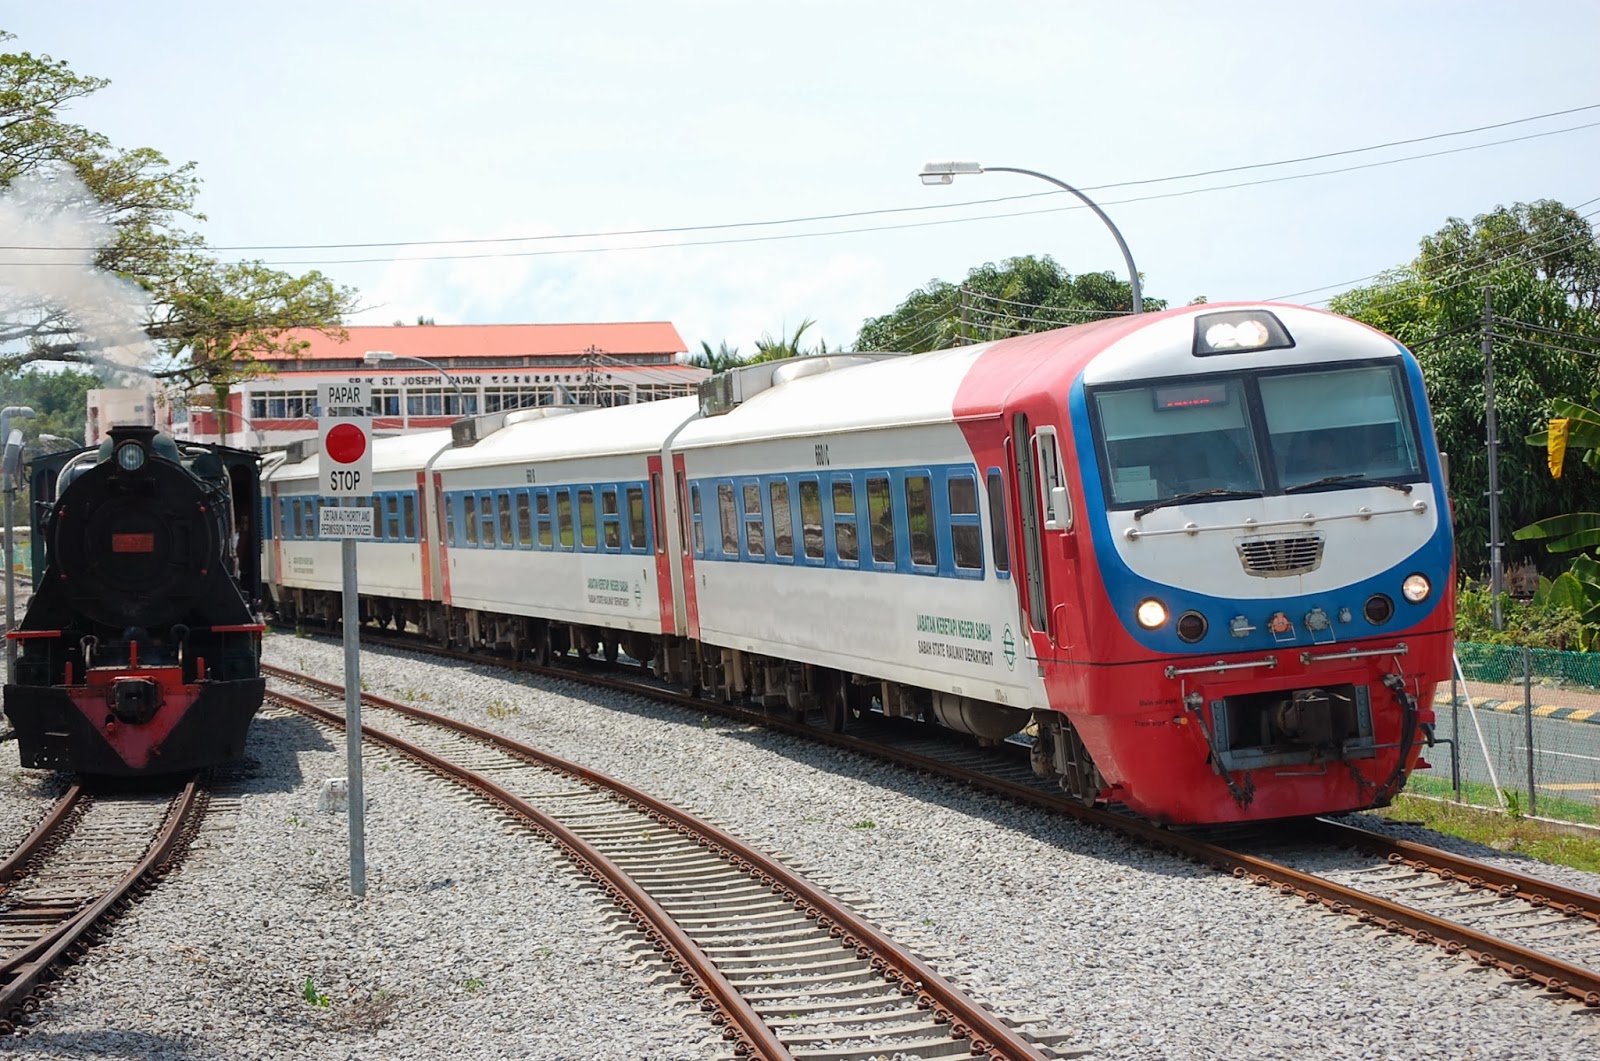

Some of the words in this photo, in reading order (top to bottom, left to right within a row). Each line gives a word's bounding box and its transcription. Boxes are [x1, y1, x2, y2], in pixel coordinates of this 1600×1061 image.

[382, 377, 396, 386] ST.
[401, 376, 442, 386] JOSEPH
[448, 376, 481, 385] PAPAR
[328, 387, 360, 403] PAPAR
[330, 471, 361, 491] STOP
[916, 614, 936, 633] JABATAN
[935, 616, 958, 637] KERETAPI
[957, 619, 975, 639] NEGERI
[975, 622, 992, 642] SABAH
[918, 640, 932, 655] SABAH
[932, 642, 945, 657] STATE
[946, 644, 964, 661] RAILWAY
[964, 647, 994, 666] DEPARTMENT
